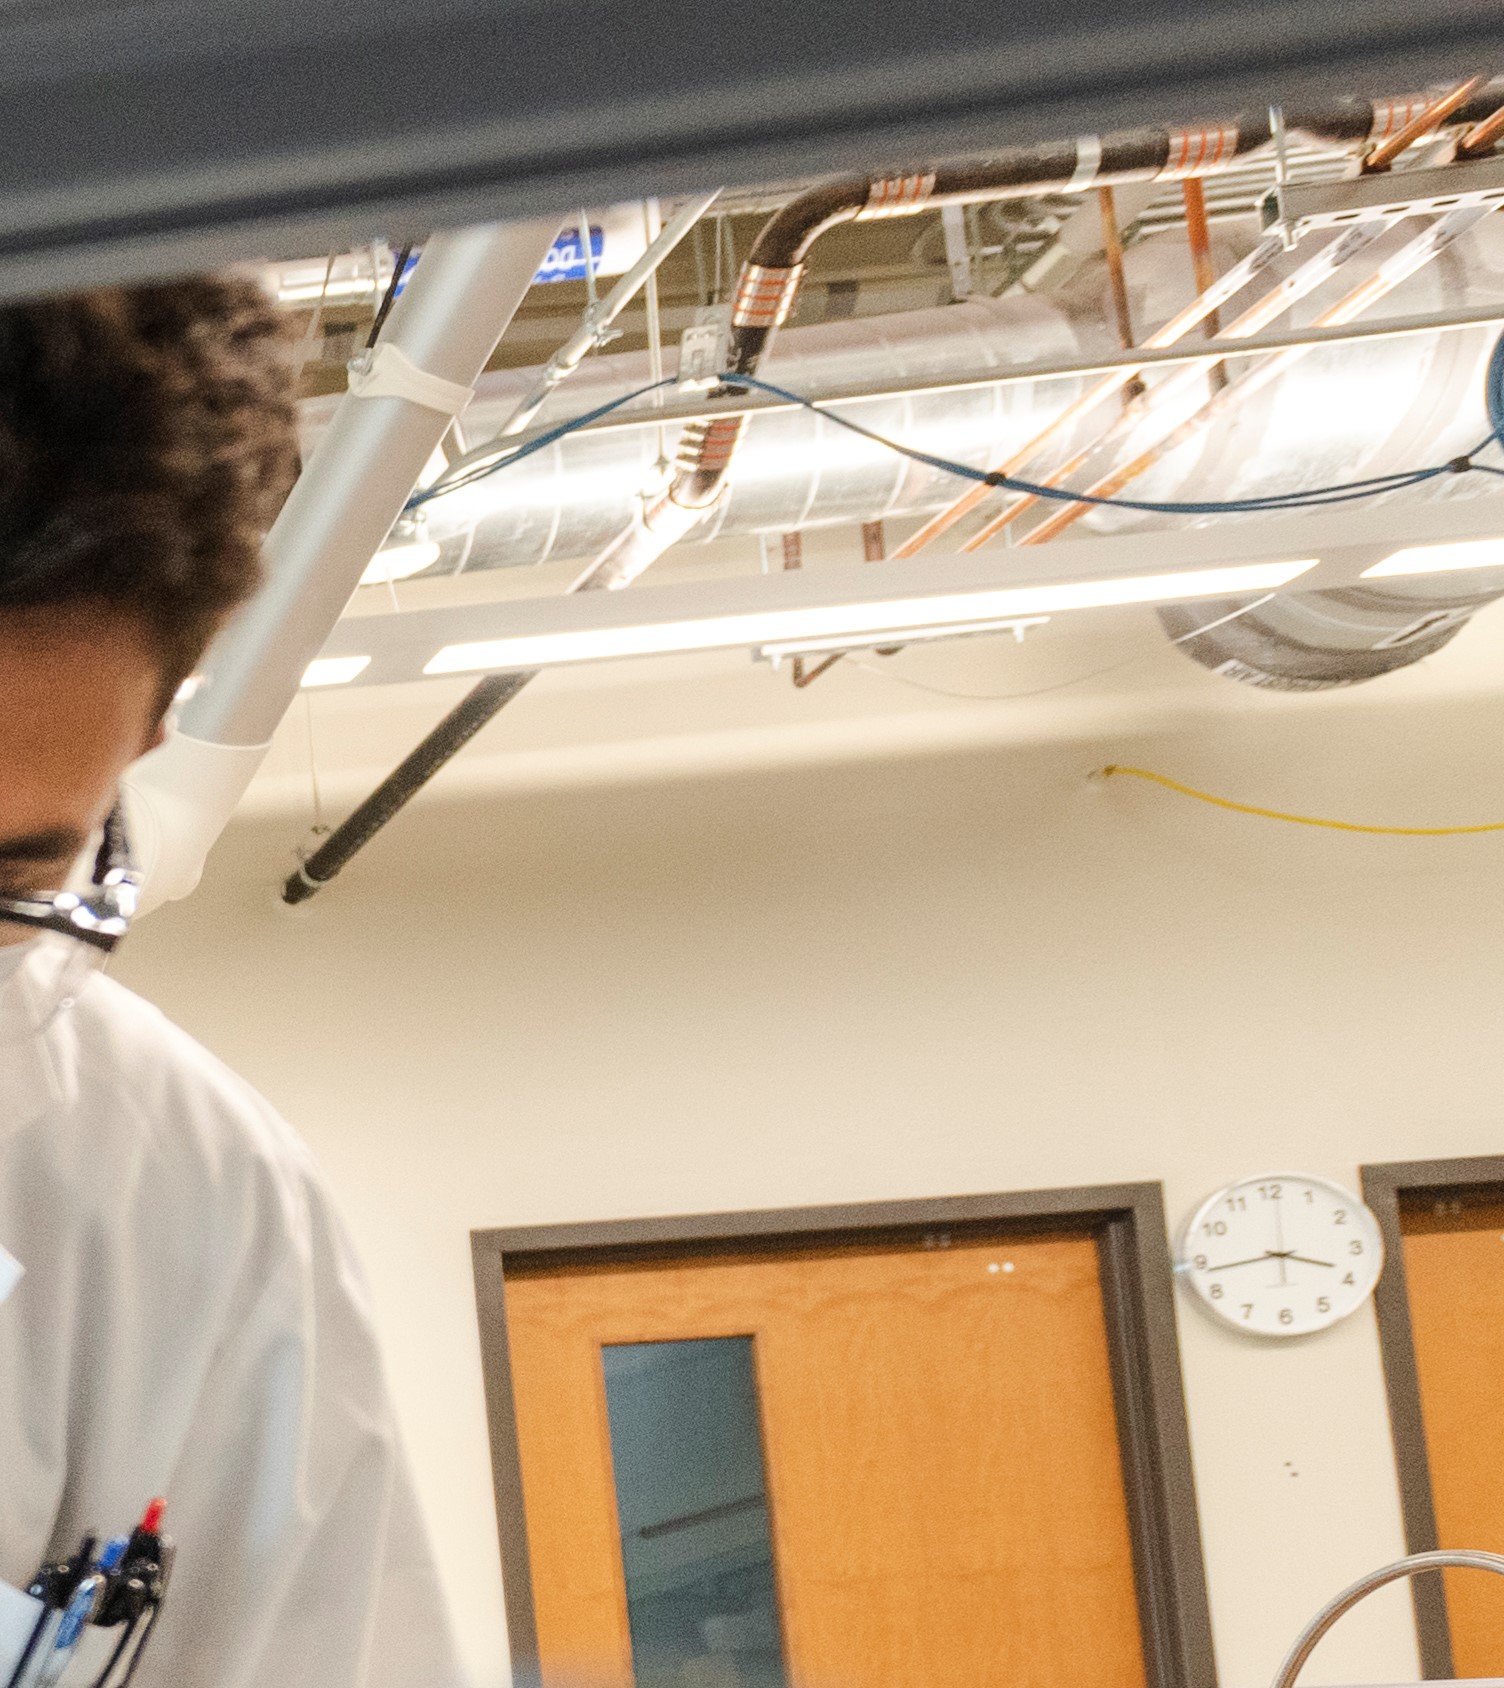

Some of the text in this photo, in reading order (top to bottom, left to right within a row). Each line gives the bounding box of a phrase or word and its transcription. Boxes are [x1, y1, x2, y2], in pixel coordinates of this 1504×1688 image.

[1257, 1184, 1282, 1200] 12
[1304, 1190, 1313, 1204] 1
[1226, 1197, 1247, 1212] 11
[1334, 1209, 1346, 1225] 2
[1202, 1221, 1227, 1236] 10
[1349, 1239, 1364, 1256] 3
[1194, 1254, 1207, 1270] 9
[1342, 1272, 1355, 1286] 4
[1209, 1283, 1223, 1300] 8
[1241, 1303, 1254, 1320] 7
[1316, 1296, 1331, 1313] 5
[1278, 1308, 1293, 1325] 6
